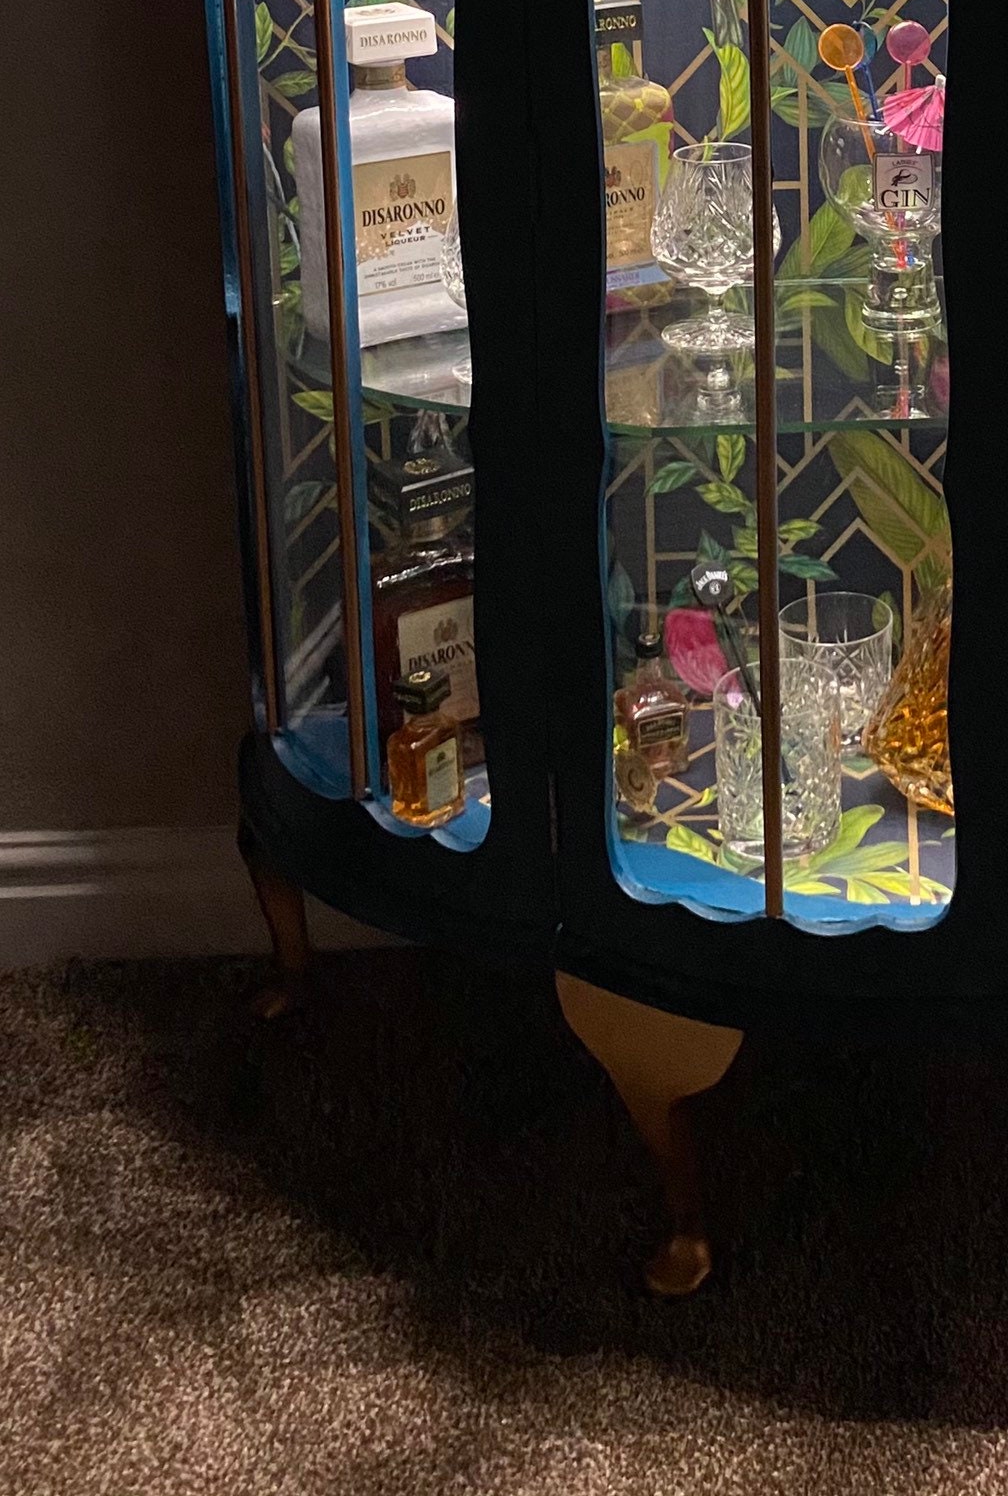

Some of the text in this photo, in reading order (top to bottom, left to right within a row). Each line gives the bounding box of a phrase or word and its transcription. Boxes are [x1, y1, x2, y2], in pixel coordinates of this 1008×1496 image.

[360, 29, 428, 48] DISARONNO
[881, 188, 931, 208] GIN
[362, 198, 446, 228] DISARONNO
[381, 226, 431, 240] VELVET
[385, 235, 426, 248] LIQUEUR
[409, 482, 471, 512] DISARONNO
